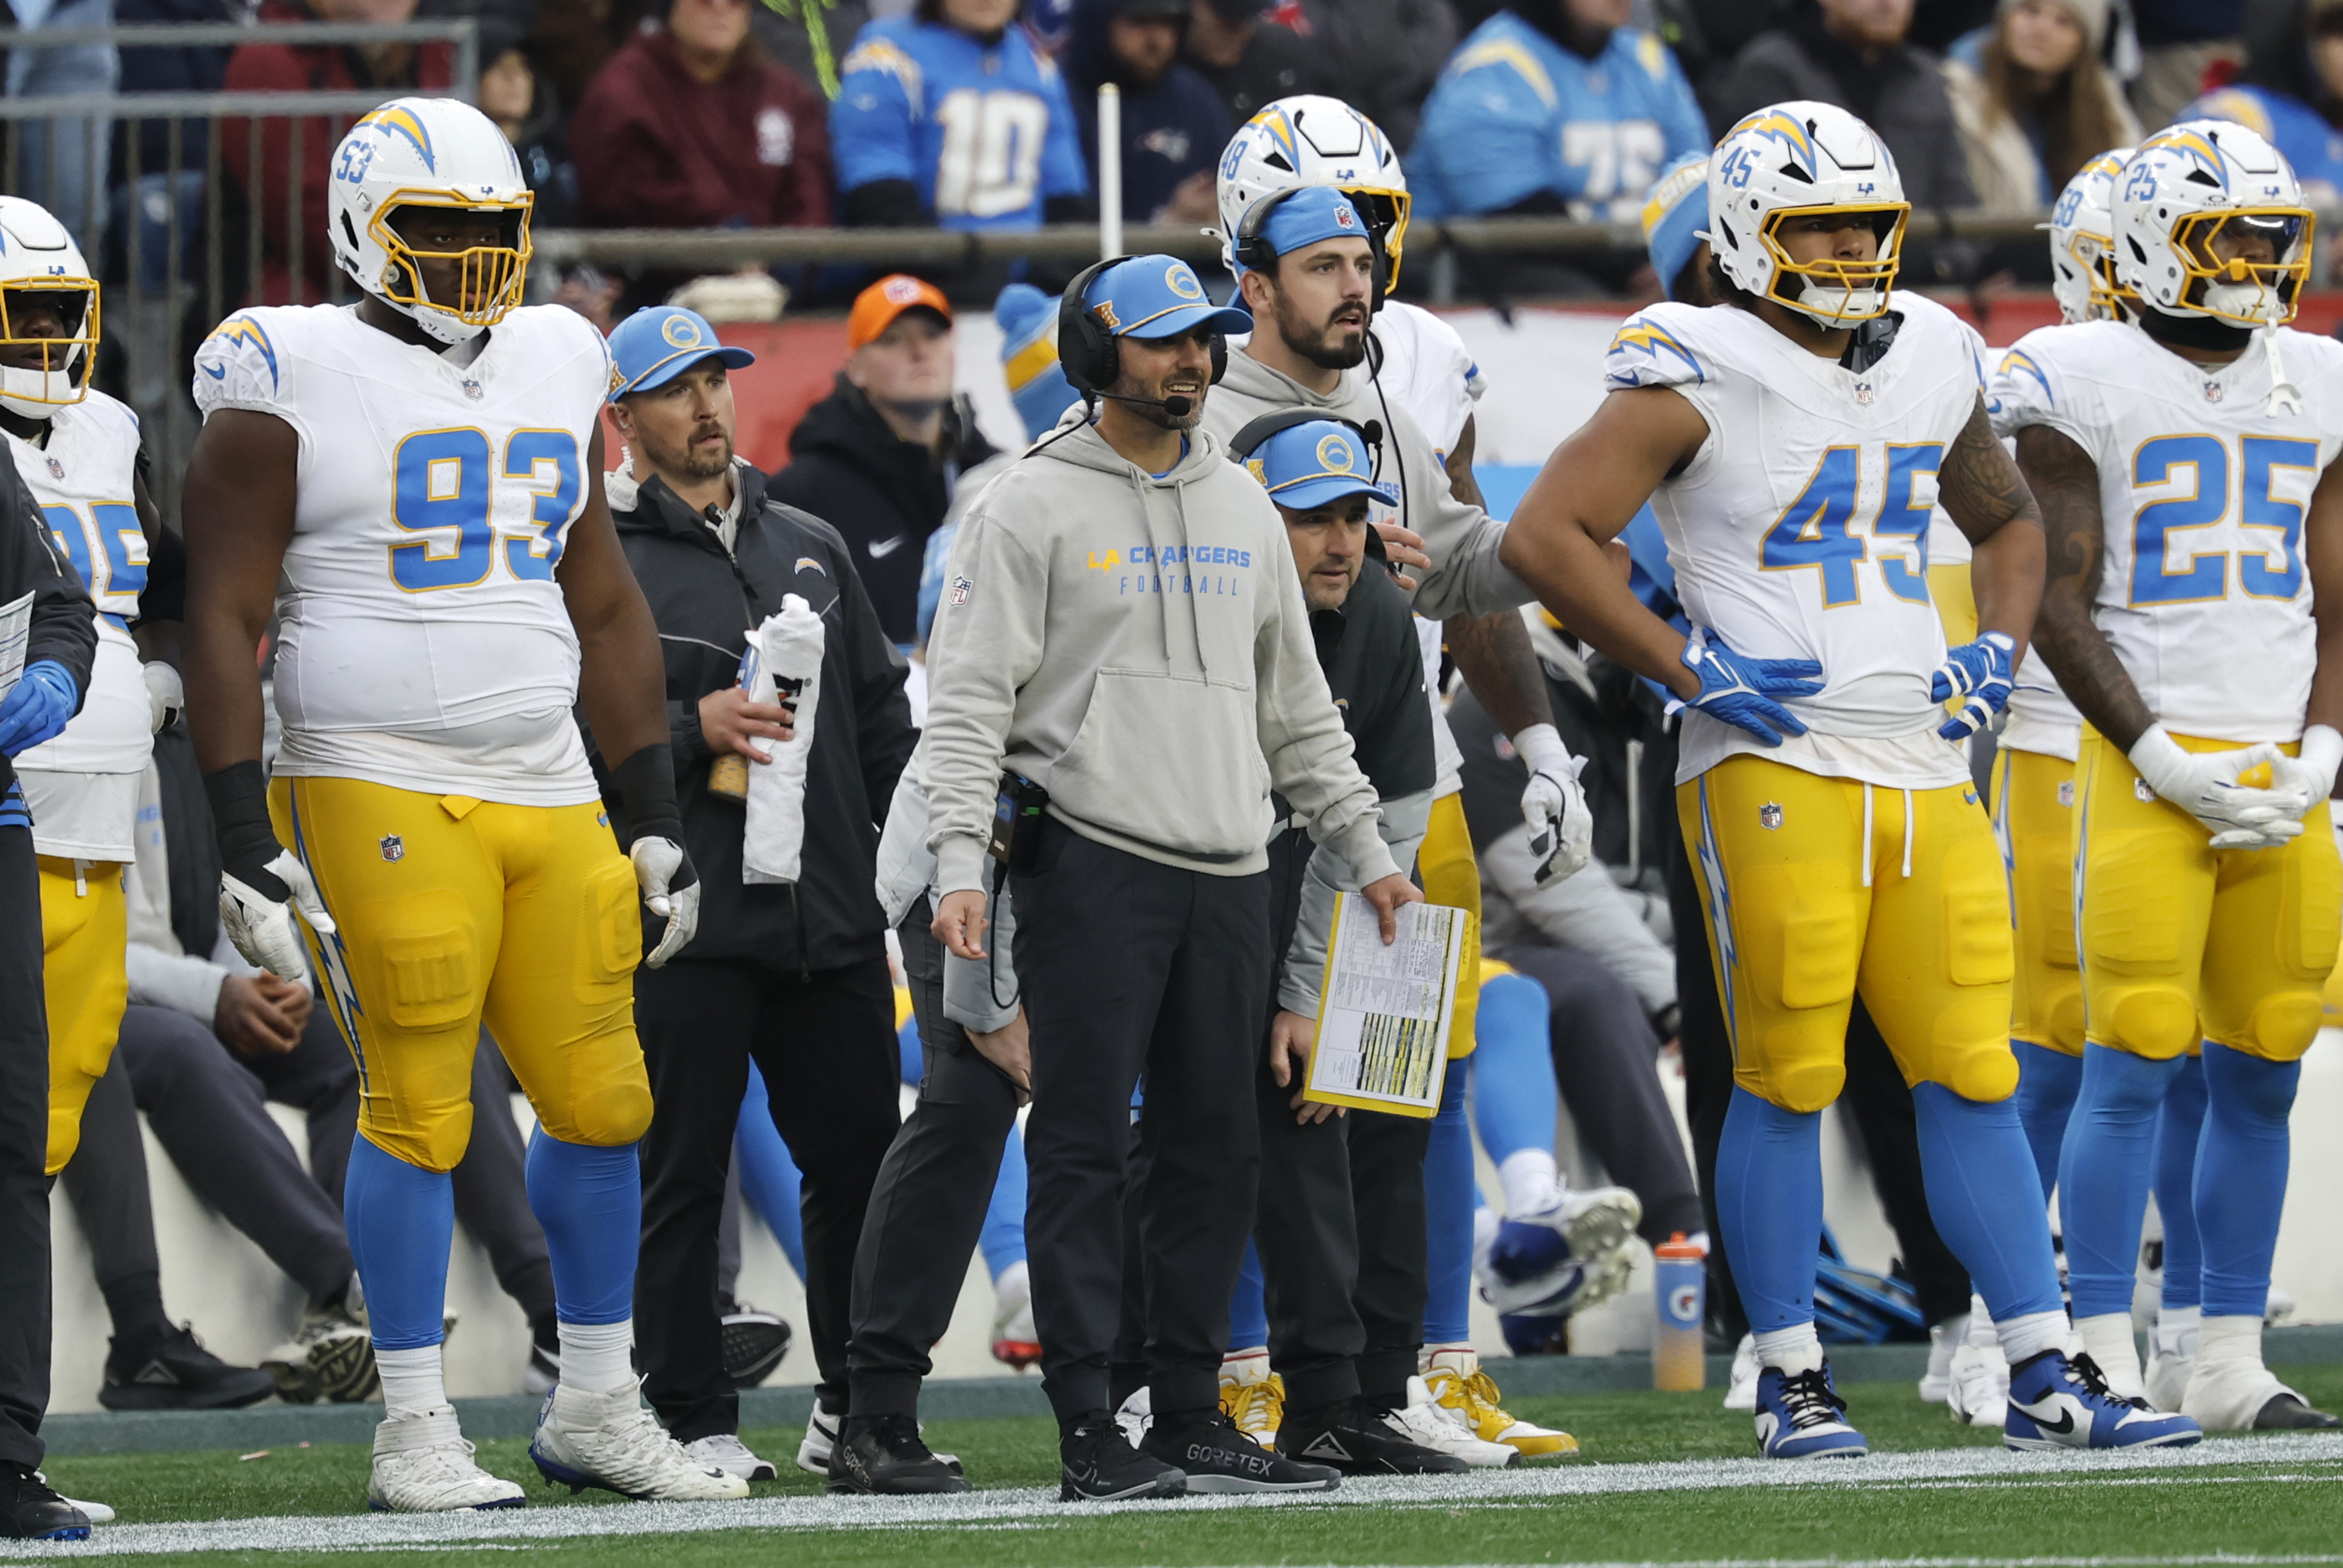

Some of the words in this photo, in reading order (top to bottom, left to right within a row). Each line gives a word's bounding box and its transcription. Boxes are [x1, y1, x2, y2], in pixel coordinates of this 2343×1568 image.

[336, 140, 377, 184] 93
[934, 88, 1050, 218] 10
[1221, 139, 1248, 180] 48
[1720, 146, 1761, 189] 45
[481, 186, 494, 196] LA
[1336, 169, 1355, 183] LA
[1858, 183, 1874, 197] LA
[2124, 163, 2167, 202] 25
[2264, 186, 2281, 200] LA
[48, 266, 65, 276] LA
[389, 426, 582, 594] 93
[1758, 441, 1946, 610] 45
[2127, 433, 2321, 609] 25
[1087, 548, 1121, 576] LA
[1129, 545, 1251, 572] CHARGERS
[1120, 574, 1237, 597] FOOTBALL
